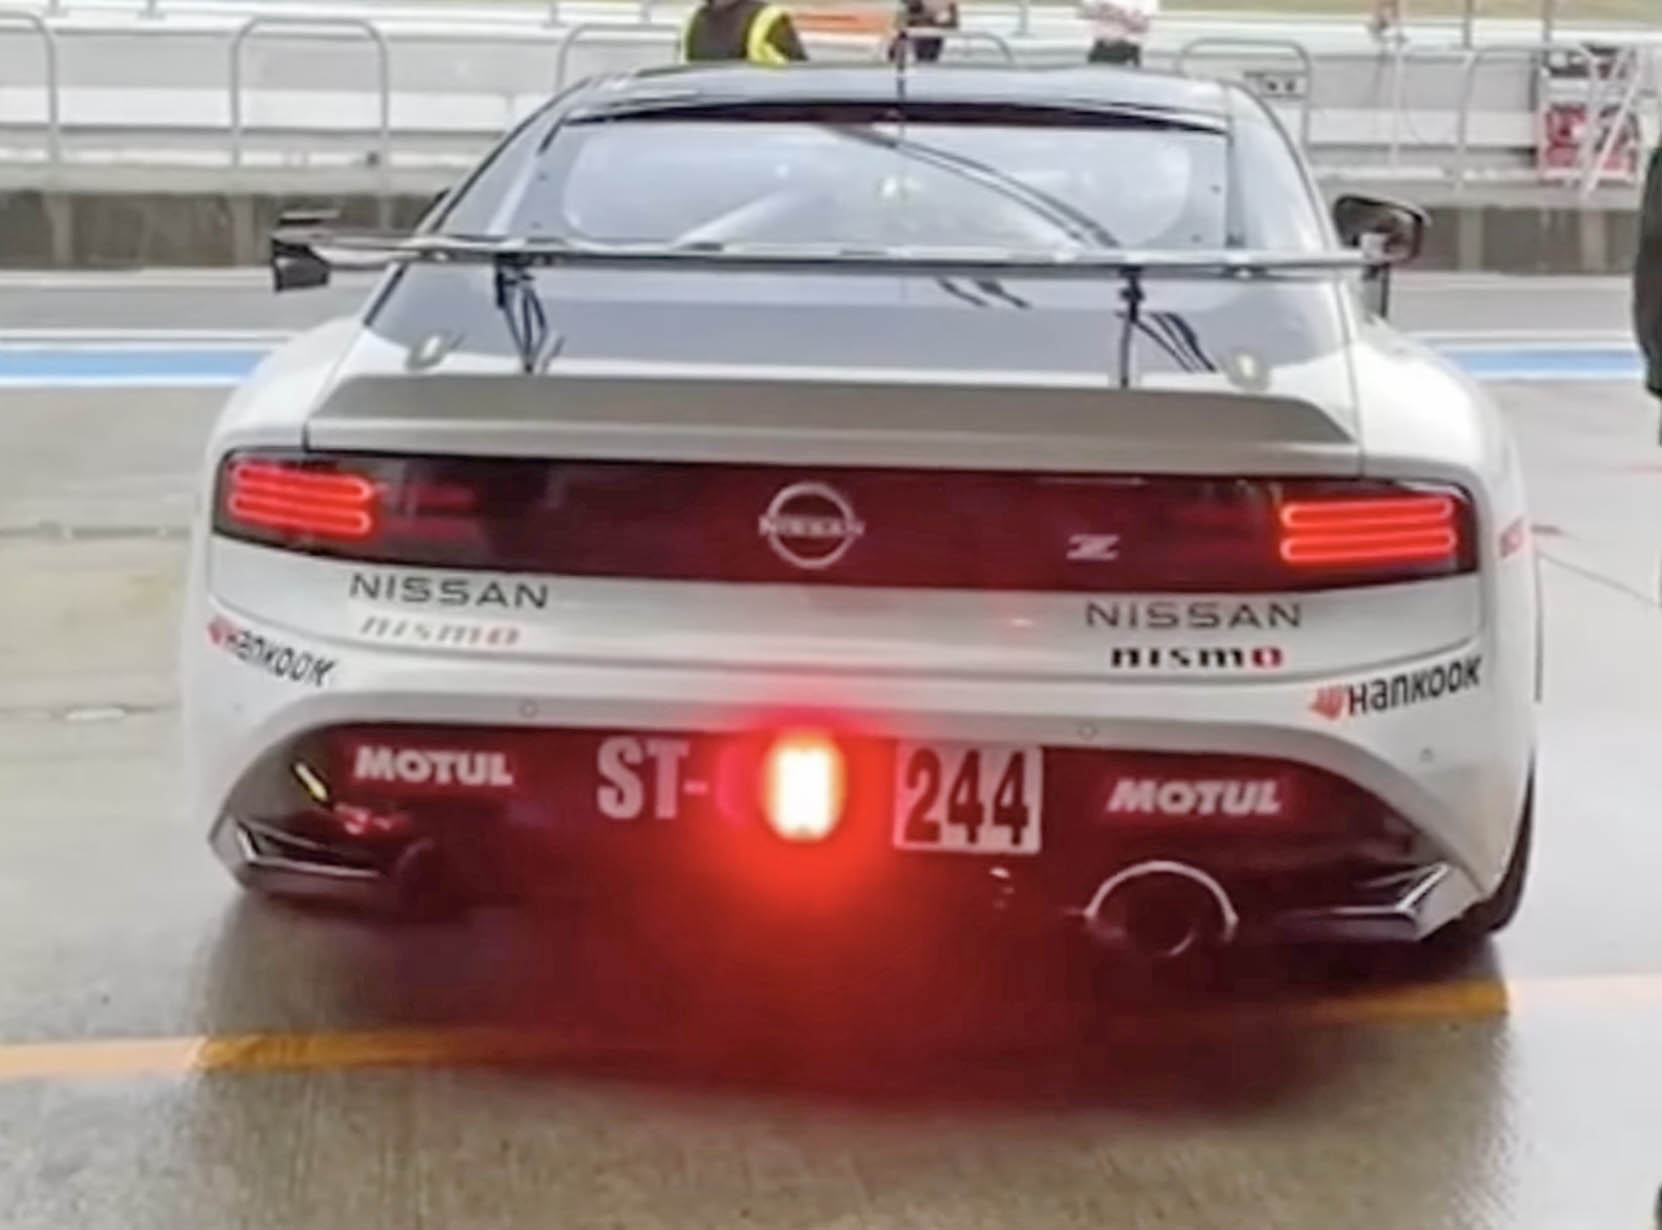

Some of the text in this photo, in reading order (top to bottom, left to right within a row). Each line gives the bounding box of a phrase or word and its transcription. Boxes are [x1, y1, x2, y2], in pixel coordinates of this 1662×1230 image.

[349, 571, 549, 609] NISSAN
[1086, 601, 1302, 629] NISSAN
[354, 745, 515, 787] MOTUL
[597, 736, 748, 824] ST-
[904, 746, 1030, 847] 244
[1106, 778, 1282, 816] MOTUL
